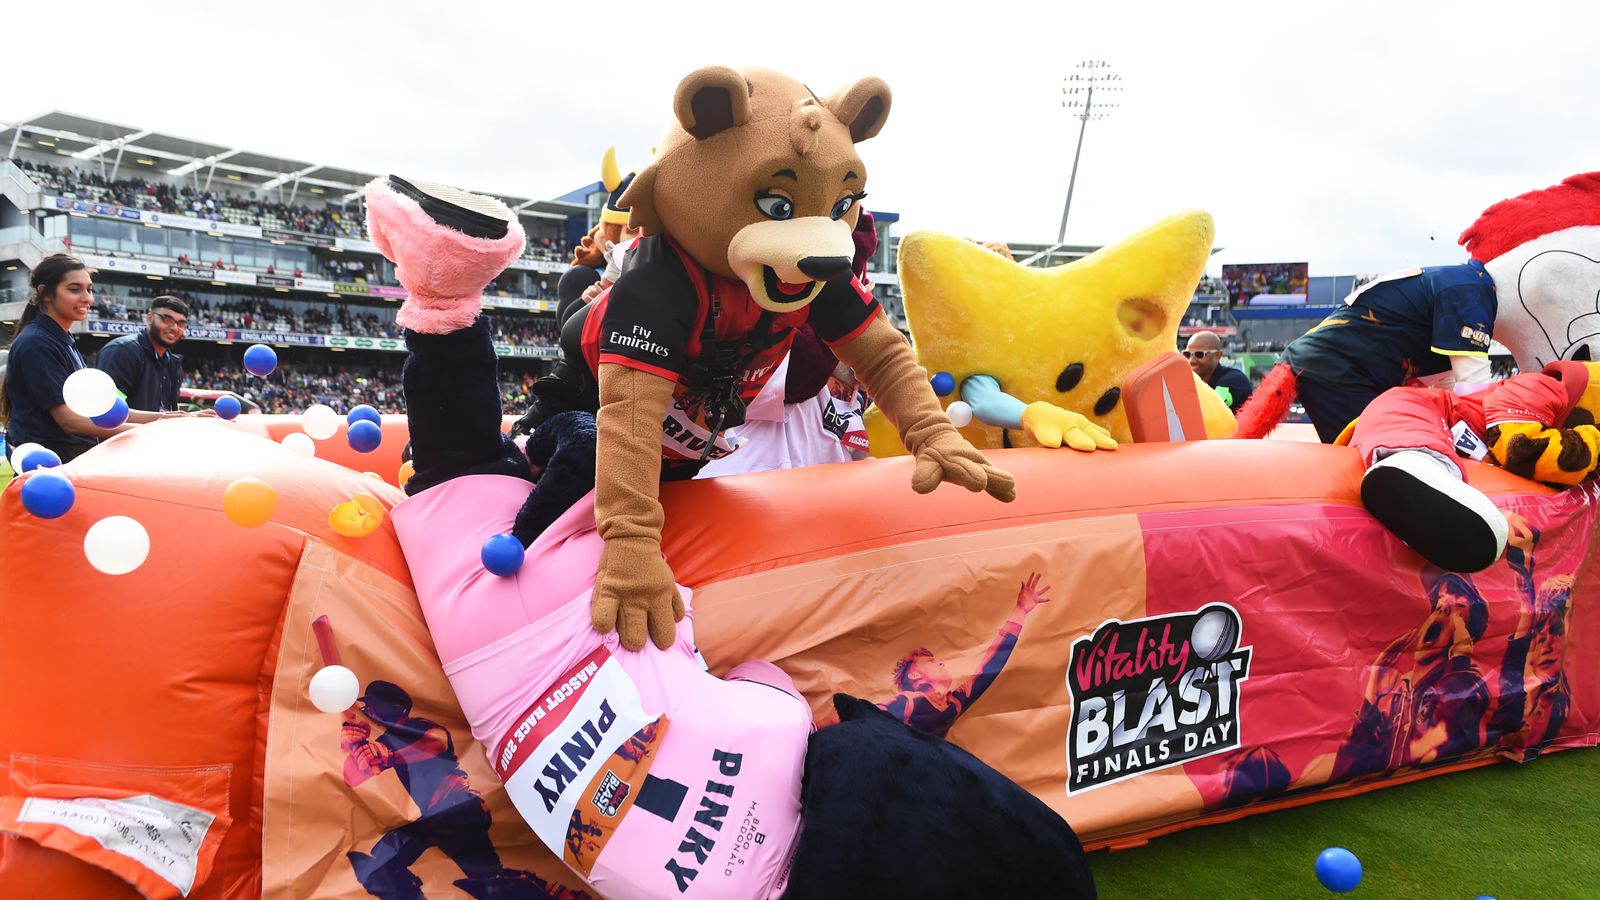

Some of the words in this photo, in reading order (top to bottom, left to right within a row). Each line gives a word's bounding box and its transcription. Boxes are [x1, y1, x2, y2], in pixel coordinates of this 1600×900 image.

[240, 333, 277, 343] ENGLAND
[285, 335, 310, 344] WALES
[609, 331, 670, 357] Emirates
[632, 325, 652, 339] Fly
[848, 434, 870, 448] MASCO
[1075, 623, 1190, 692] Vitality
[545, 660, 599, 712] MASCOT
[1076, 658, 1243, 759] BLAST
[513, 705, 547, 744] RACE
[533, 698, 617, 814] PINKY
[1076, 739, 1171, 784] FINALS
[1184, 721, 1232, 753] DAY
[596, 775, 620, 813] BLAST
[665, 748, 743, 894] PINKY
[724, 800, 758, 877] MACDONALD
[737, 817, 760, 866] BROOS
